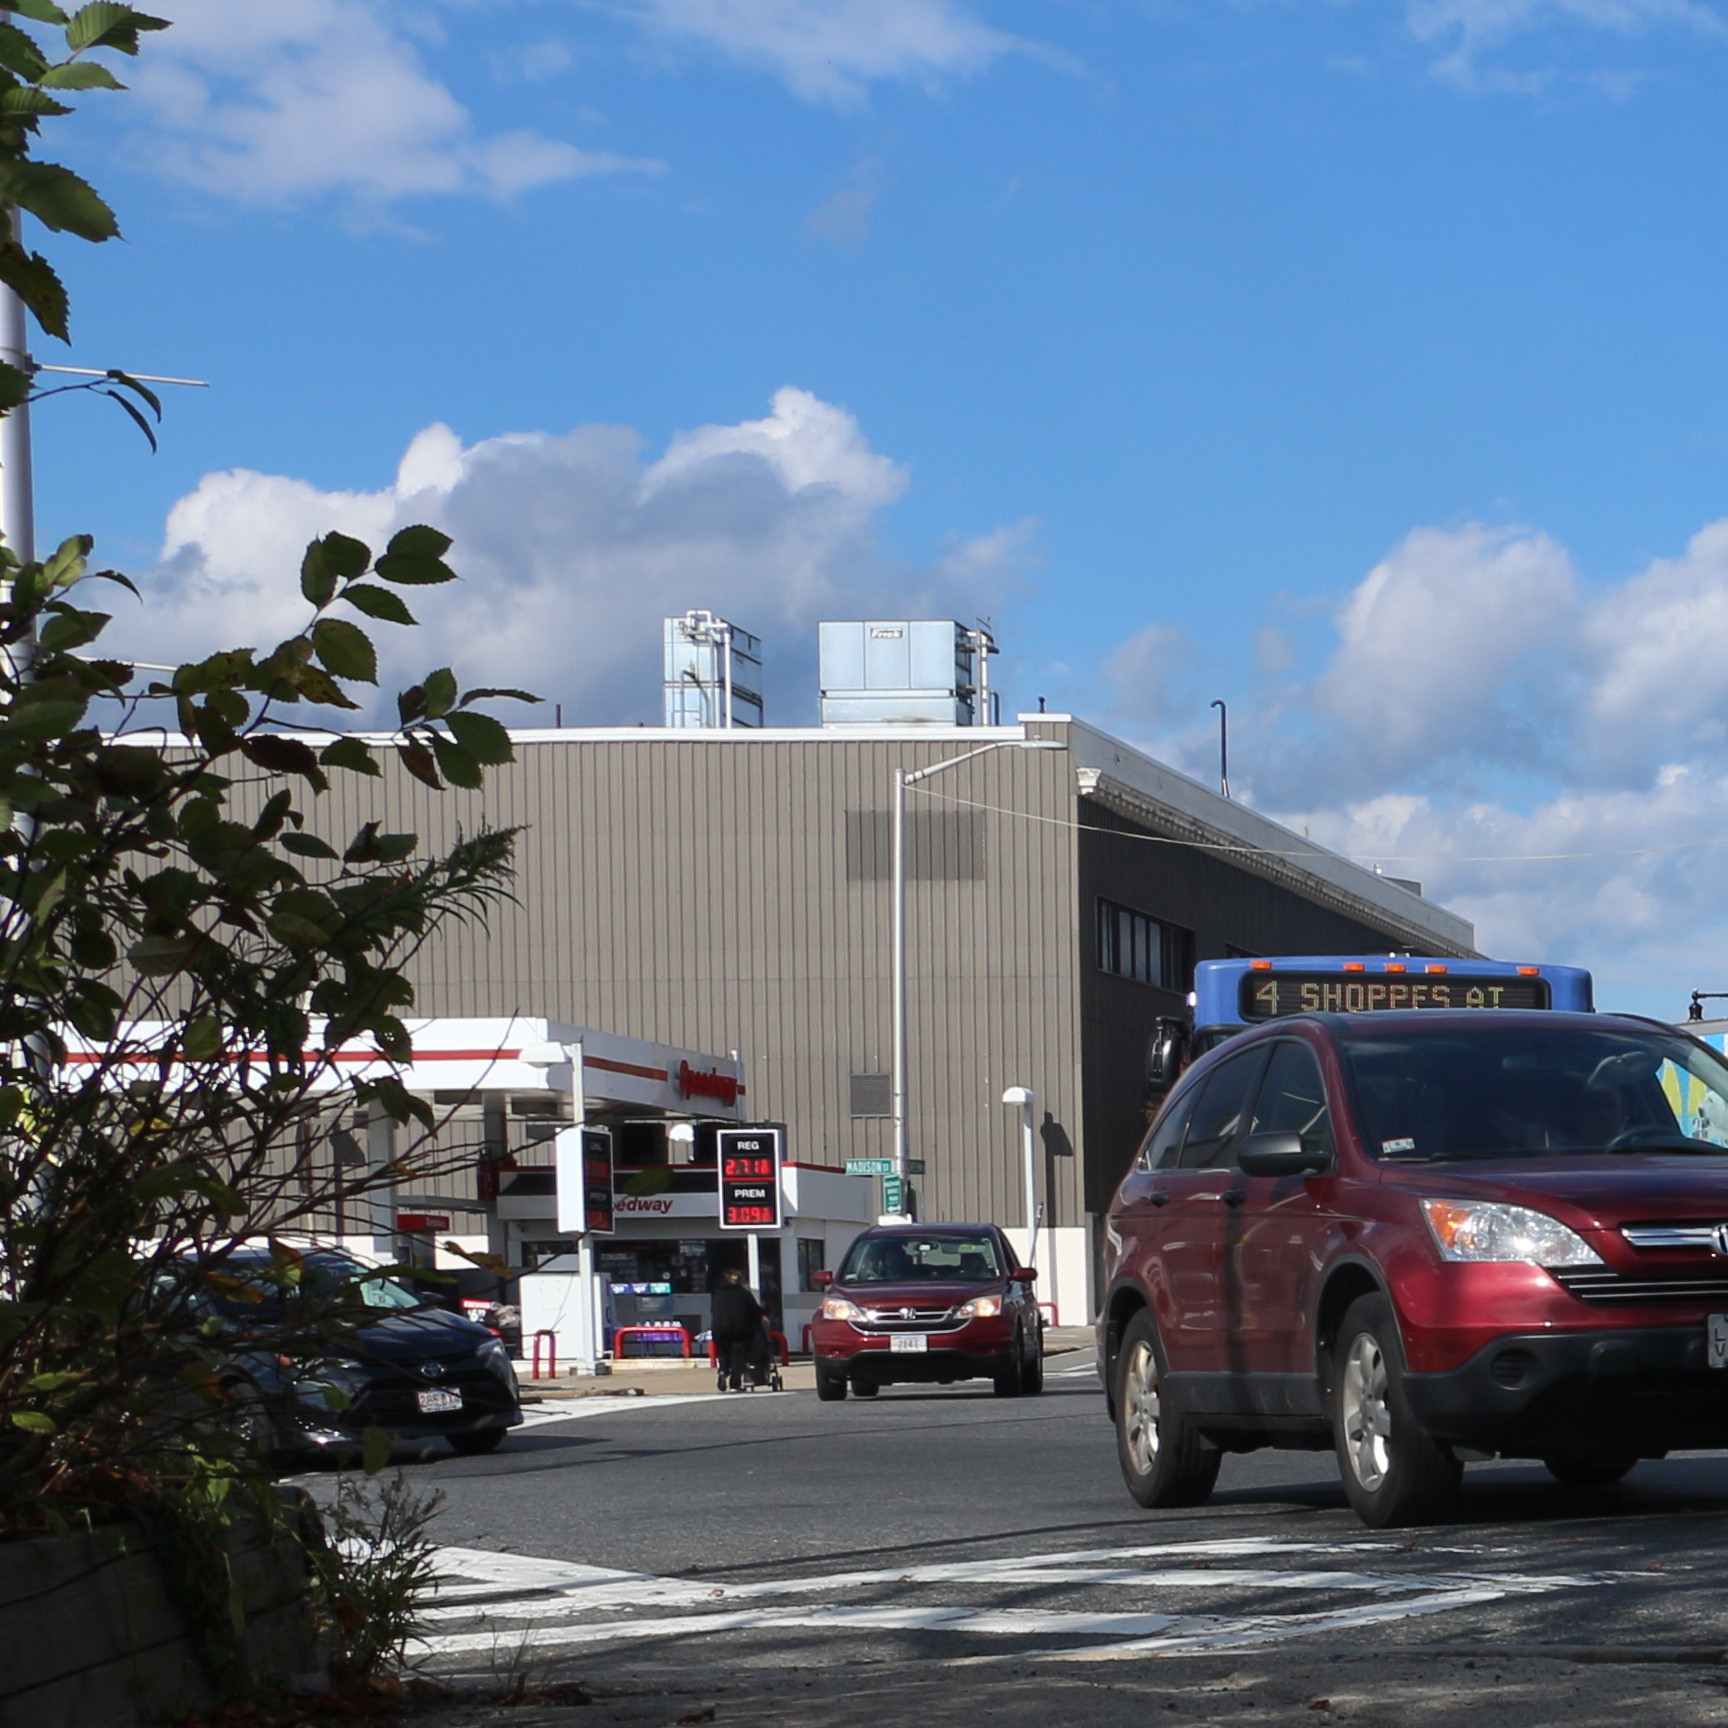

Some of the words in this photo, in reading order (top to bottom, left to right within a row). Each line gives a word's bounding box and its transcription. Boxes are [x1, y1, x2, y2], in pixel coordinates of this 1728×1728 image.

[1256, 980, 1280, 1015] 4
[1301, 983, 1451, 1013] SHOPPES
[1466, 985, 1504, 1010] AT
[737, 1141, 760, 1150] REG
[846, 1161, 882, 1173] MADISON
[734, 1189, 766, 1198] PREM
[613, 1196, 673, 1215] eedway
